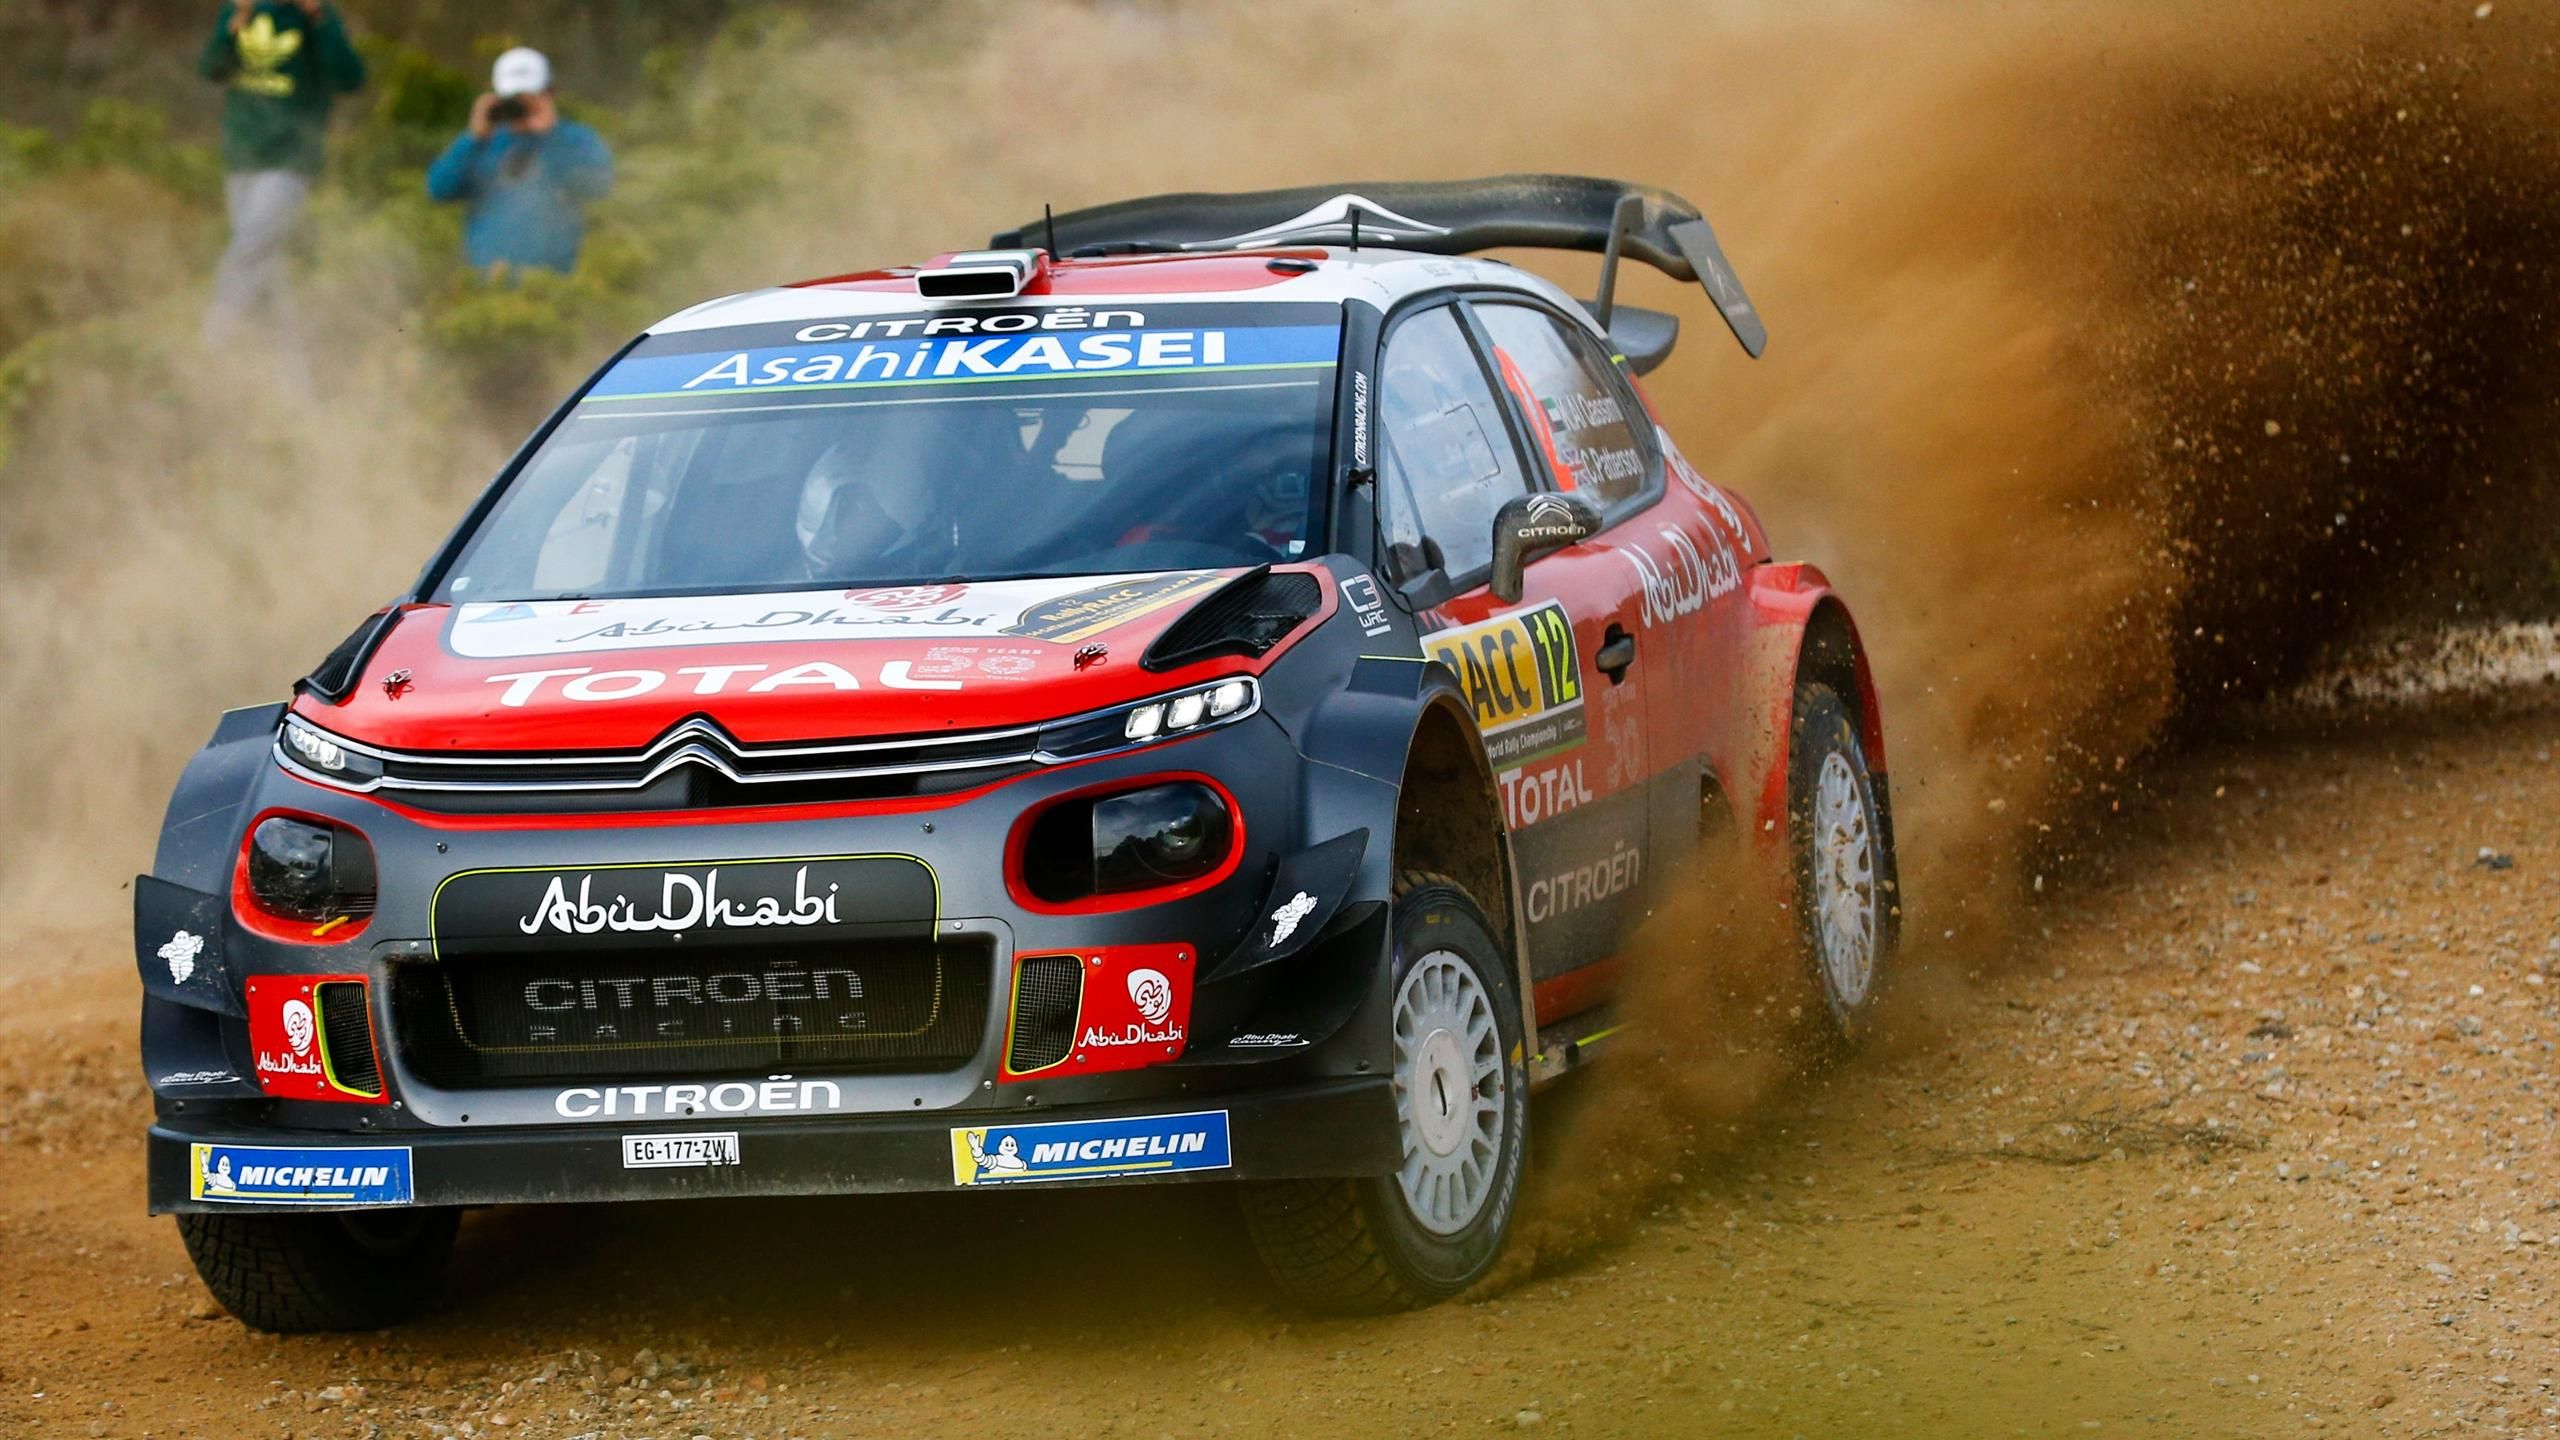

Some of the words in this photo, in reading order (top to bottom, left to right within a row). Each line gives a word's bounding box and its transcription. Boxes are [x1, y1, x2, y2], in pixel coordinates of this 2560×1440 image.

[1340, 574, 1381, 613] C3
[1358, 609, 1387, 628] WRC
[1533, 609, 1576, 704] 12
[484, 660, 963, 707] TOTAL
[1500, 759, 1593, 829] TOTAL
[634, 1139, 727, 1161] EG-177-ZW
[1030, 1131, 1208, 1164] MICHELIN
[238, 1166, 389, 1188] MICHELIN
